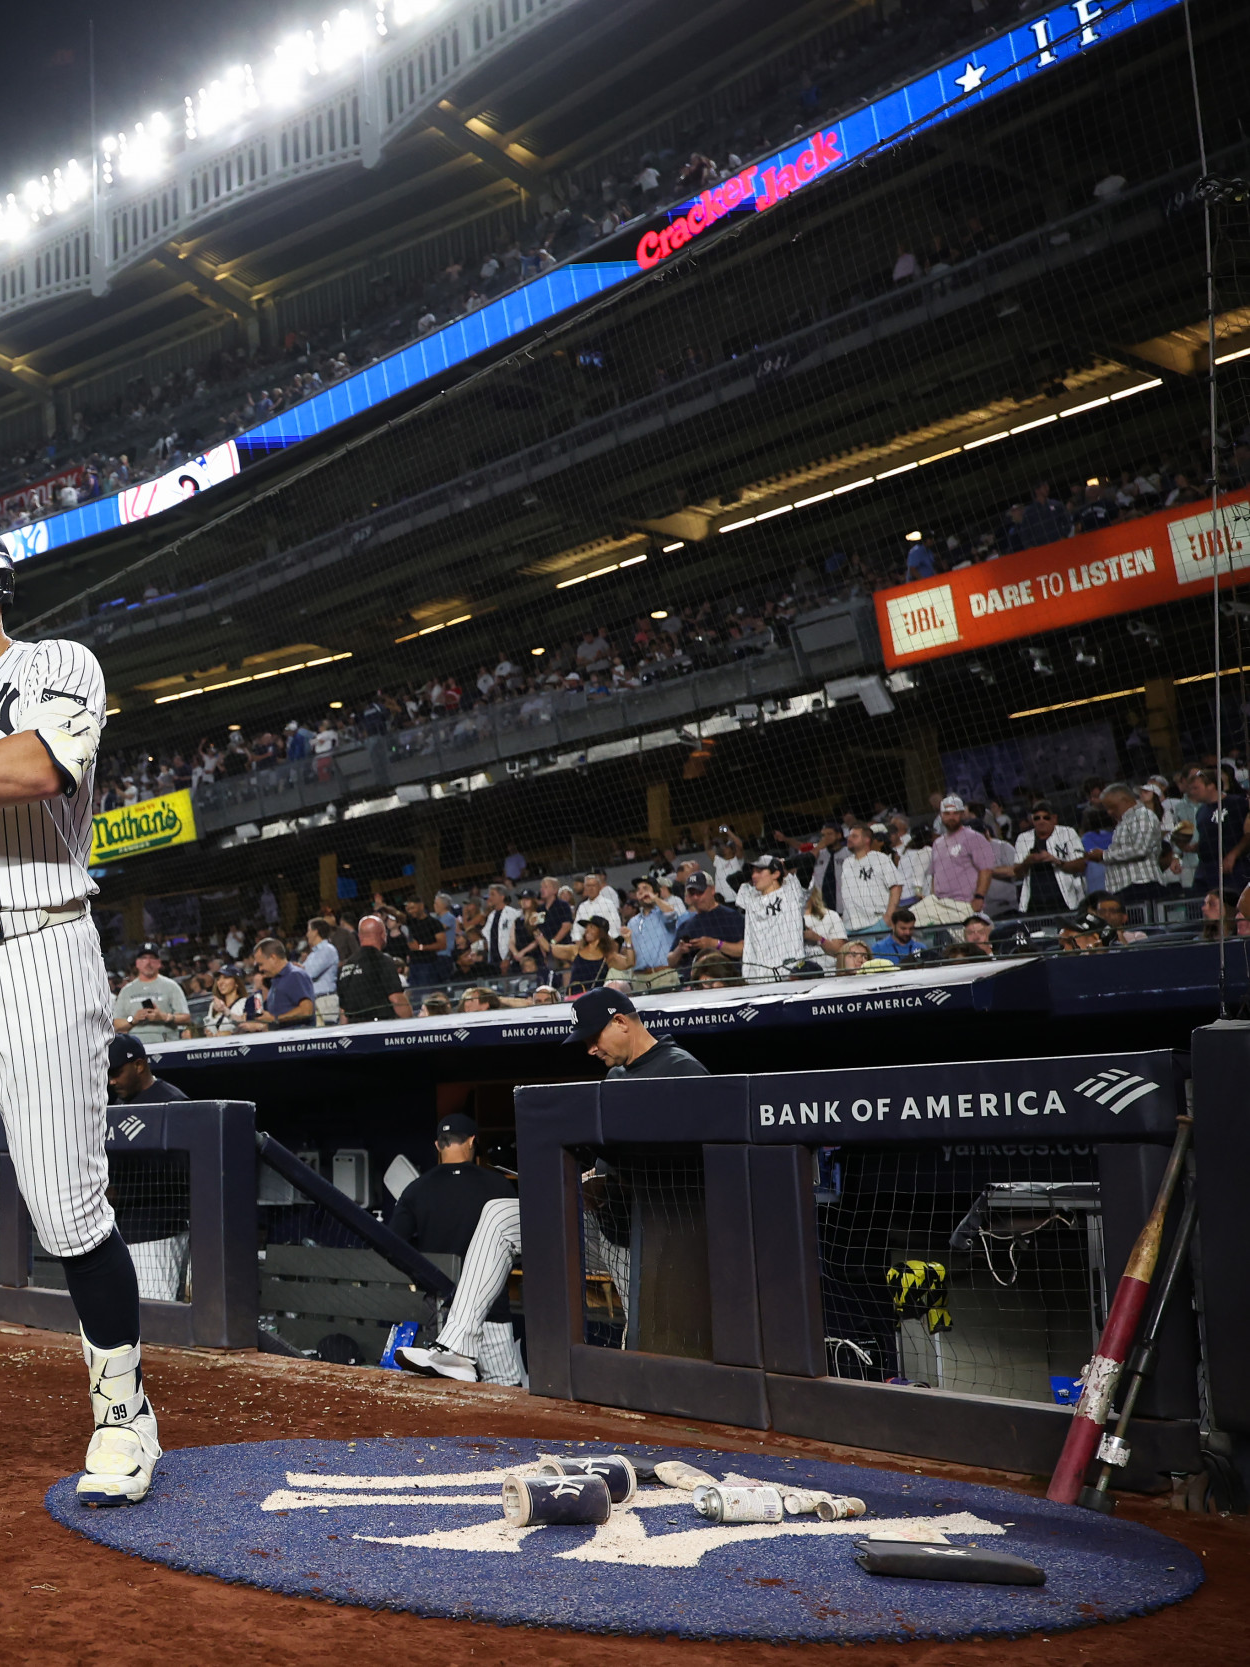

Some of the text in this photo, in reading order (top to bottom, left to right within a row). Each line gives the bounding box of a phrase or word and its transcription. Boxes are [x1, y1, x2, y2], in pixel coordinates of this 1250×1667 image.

[1030, 0, 1103, 67] IF
[755, 131, 843, 212] Jack
[636, 166, 758, 270] Cracker
[903, 526, 1242, 636] JBL DARE TO LISTEN JBL
[92, 801, 177, 849] Nathan's
[812, 997, 922, 1015] BANK OF AMERICA
[644, 1013, 735, 1029] BANK OF AMERICA
[385, 1034, 452, 1046] BANK OF AMERICA
[502, 1025, 574, 1038] BANK OF AMERIC
[187, 1050, 238, 1061] BANK OF AMERICA
[278, 1042, 337, 1053] BANK OF AMERICA
[760, 1089, 1067, 1127] BANK OF AMERICA
[112, 1404, 127, 1420] 99
